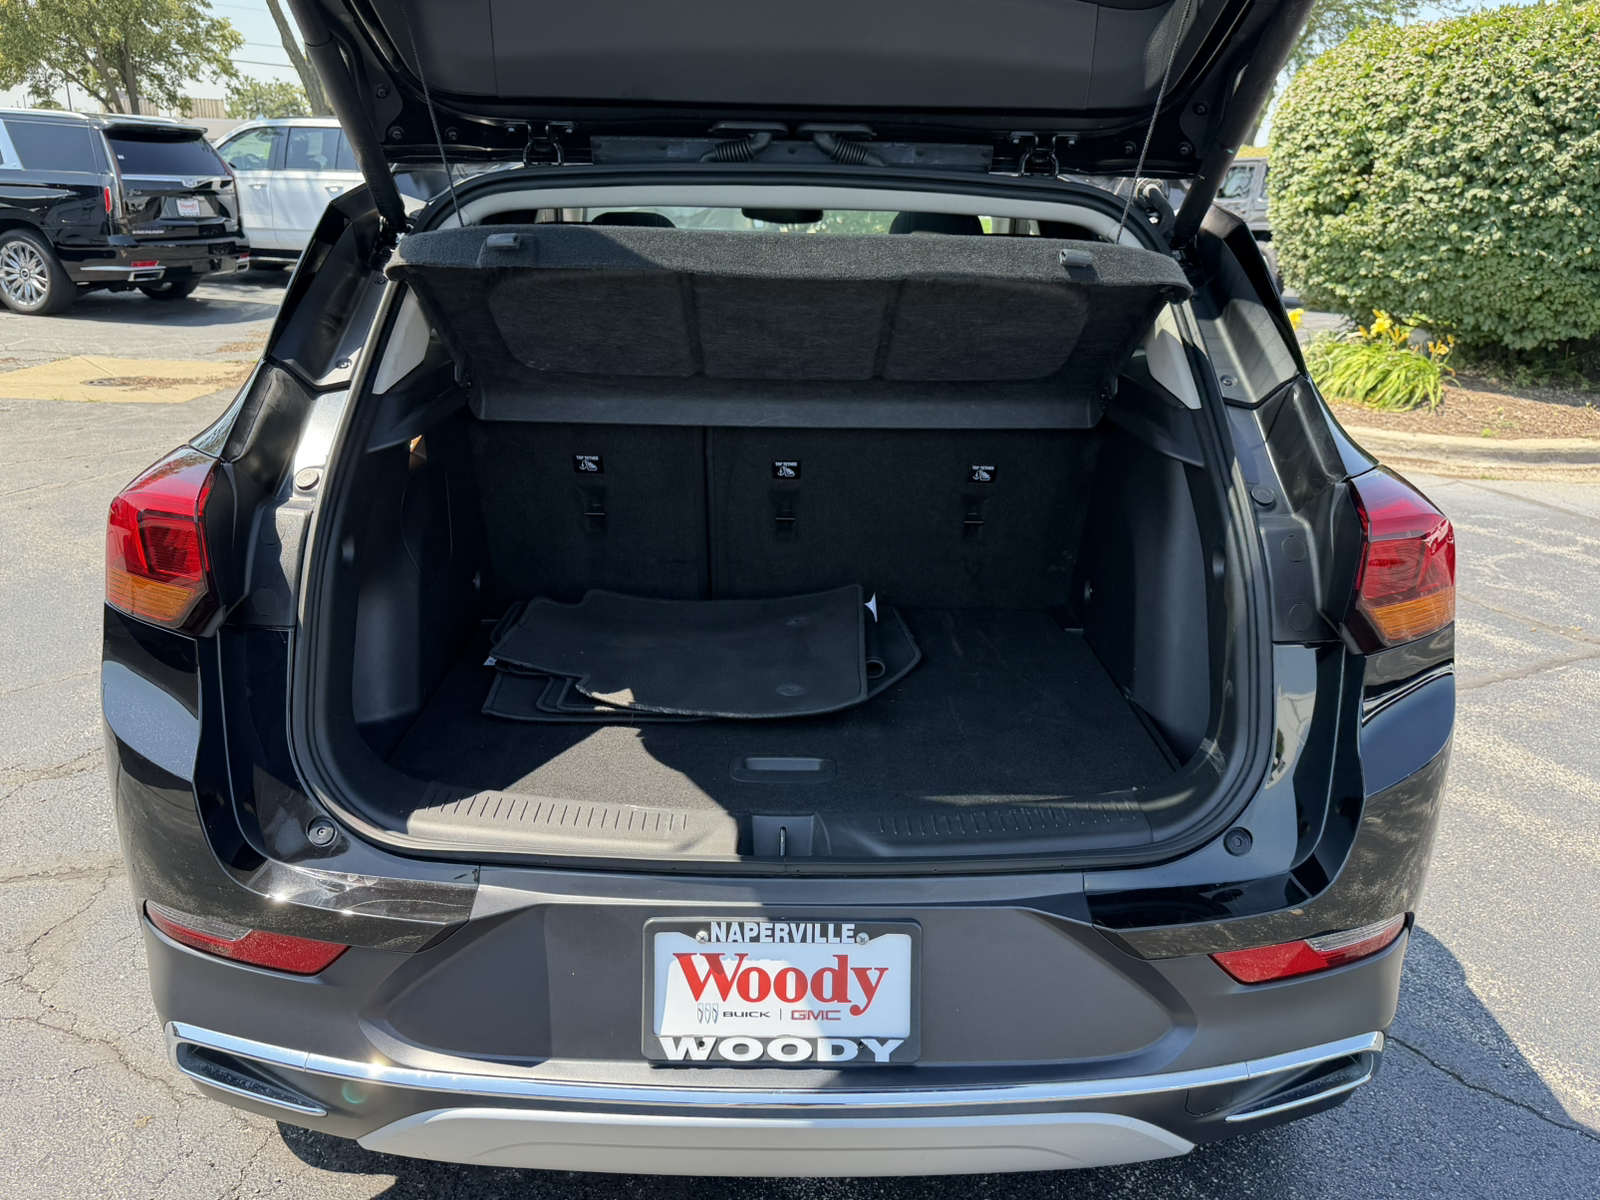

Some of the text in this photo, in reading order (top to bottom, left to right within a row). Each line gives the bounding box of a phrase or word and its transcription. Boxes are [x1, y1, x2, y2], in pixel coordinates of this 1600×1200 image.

[710, 921, 856, 944] NAPERVILLE
[672, 952, 889, 1017] Woody
[722, 1009, 842, 1021] BUICK GMC
[658, 1036, 905, 1063] WOODY
